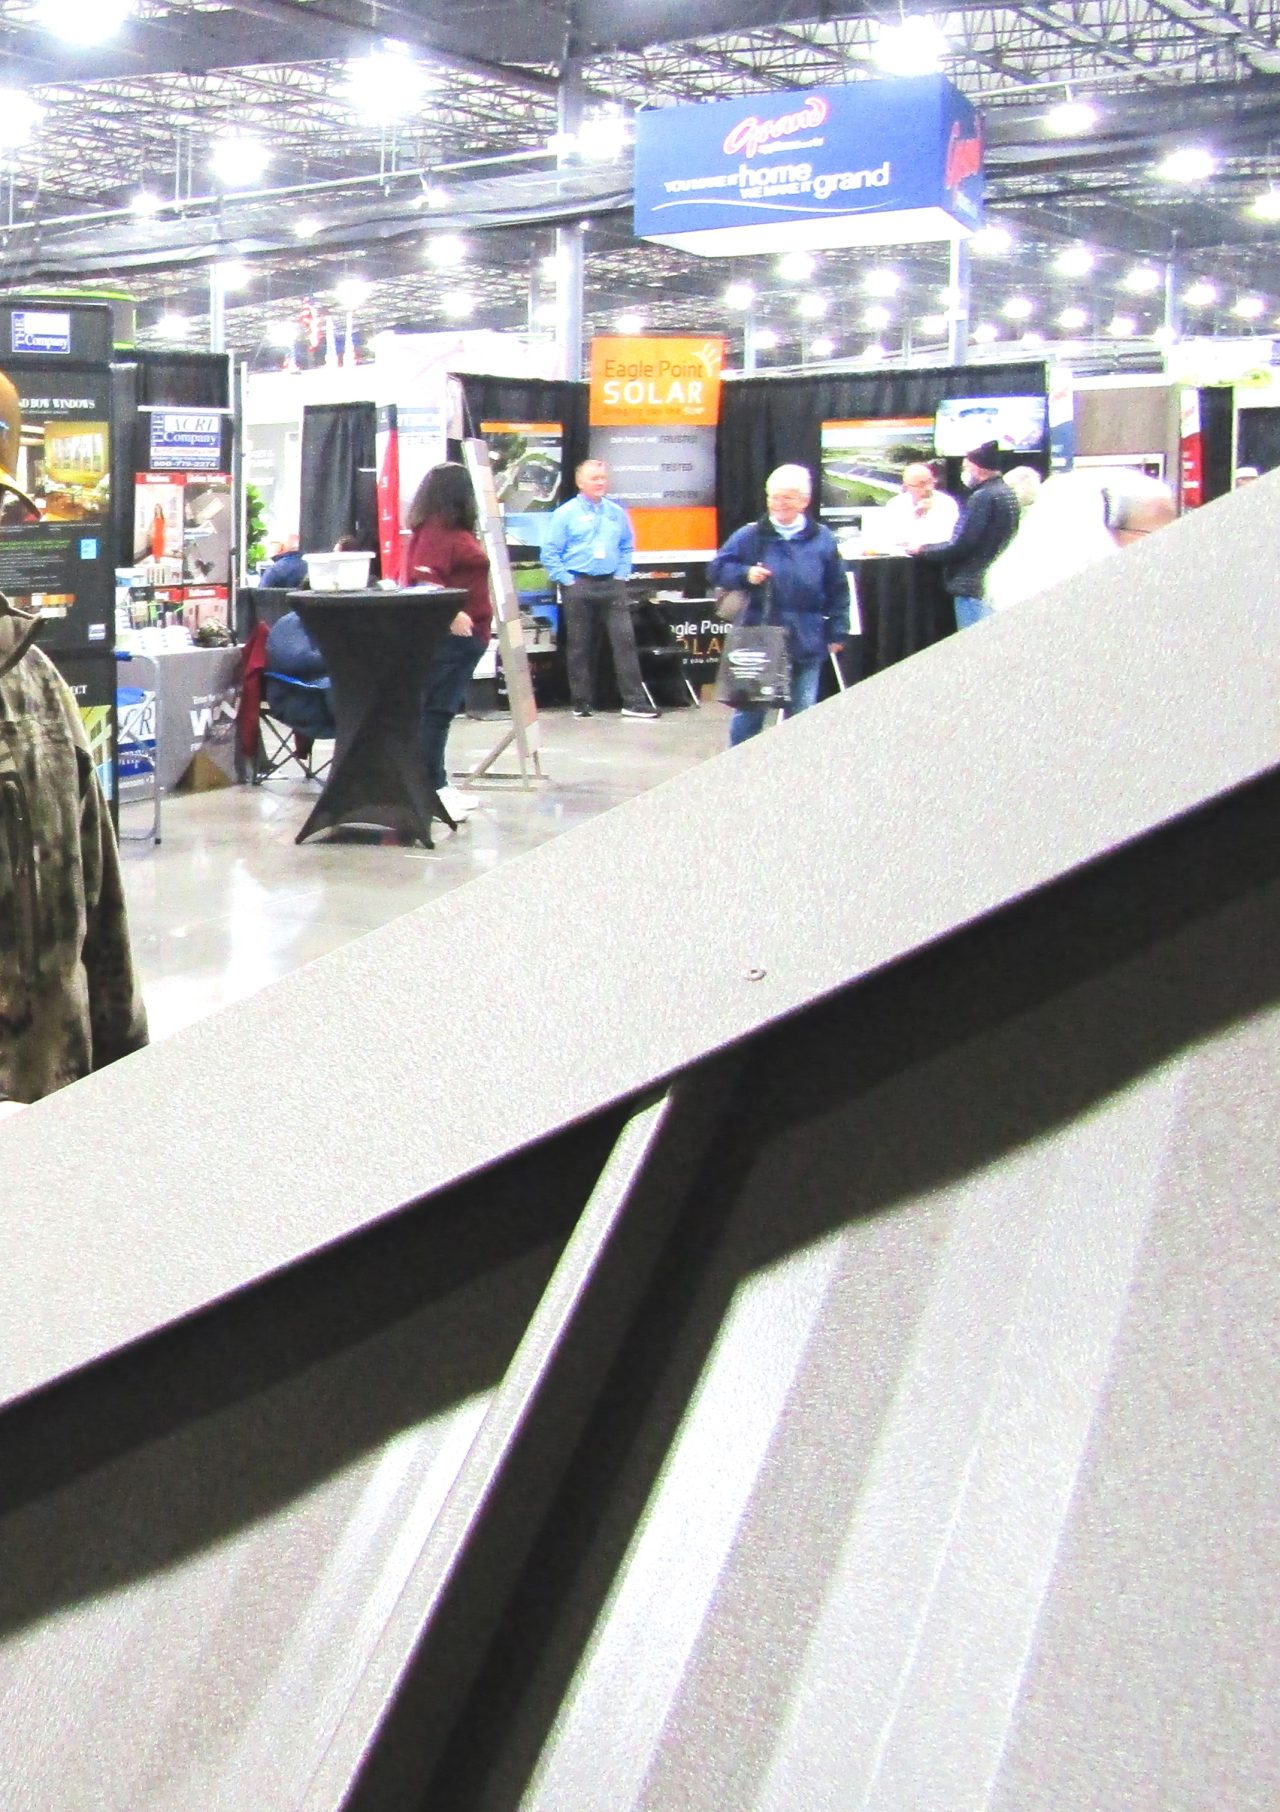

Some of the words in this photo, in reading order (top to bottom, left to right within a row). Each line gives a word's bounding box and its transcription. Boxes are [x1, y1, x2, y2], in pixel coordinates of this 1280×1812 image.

[738, 163, 813, 187] home
[812, 161, 890, 199] grand
[24, 333, 68, 350] Company
[604, 360, 654, 381] Eagle
[660, 360, 703, 378] Point
[603, 381, 704, 405] SOLAR
[163, 431, 217, 446] Company
[701, 619, 734, 635] Poin
